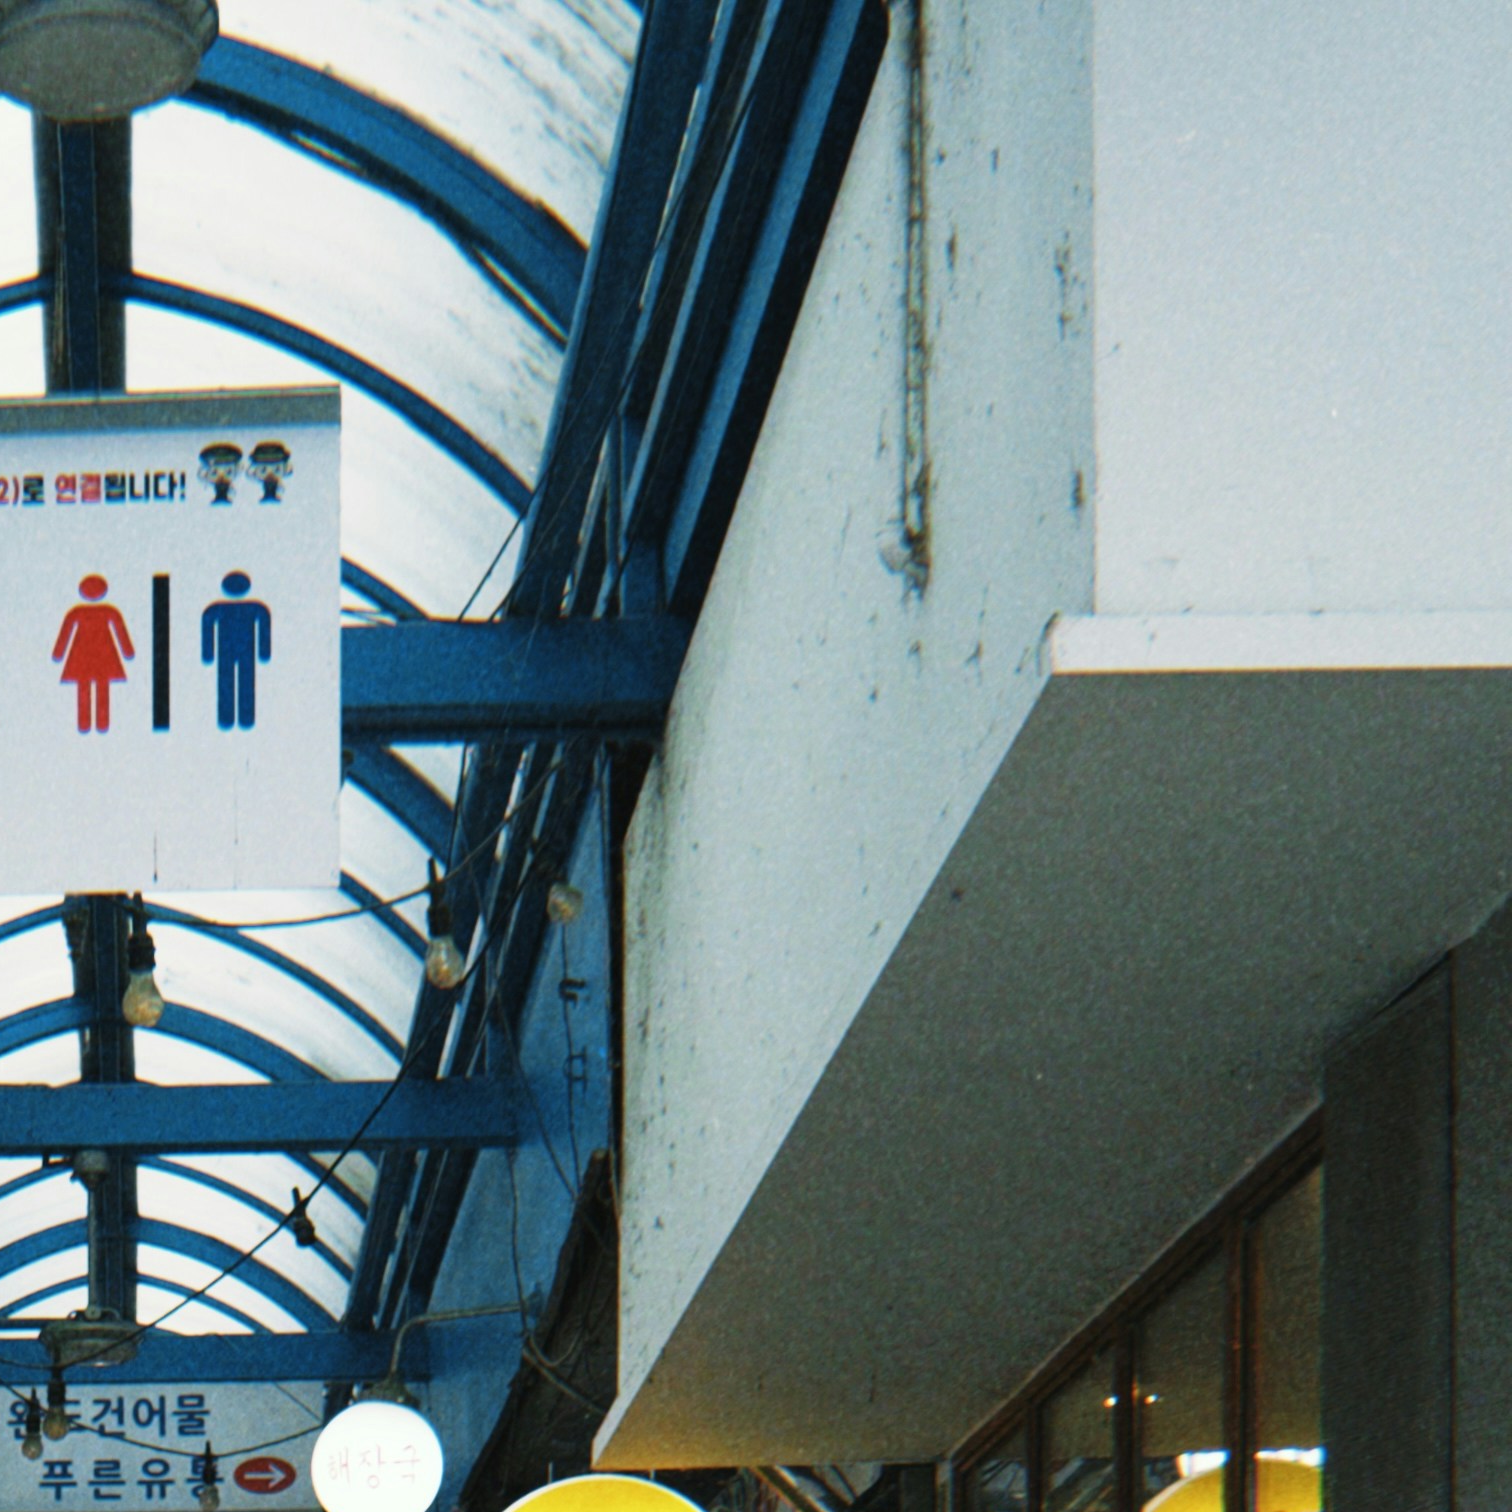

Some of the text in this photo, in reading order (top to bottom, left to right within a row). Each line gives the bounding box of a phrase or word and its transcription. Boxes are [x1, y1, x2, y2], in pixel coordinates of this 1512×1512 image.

[54, 469, 186, 505] 연결됩니다!
[39, 1457, 224, 1503] 푸른유통
[326, 1444, 422, 1491] 해장국
